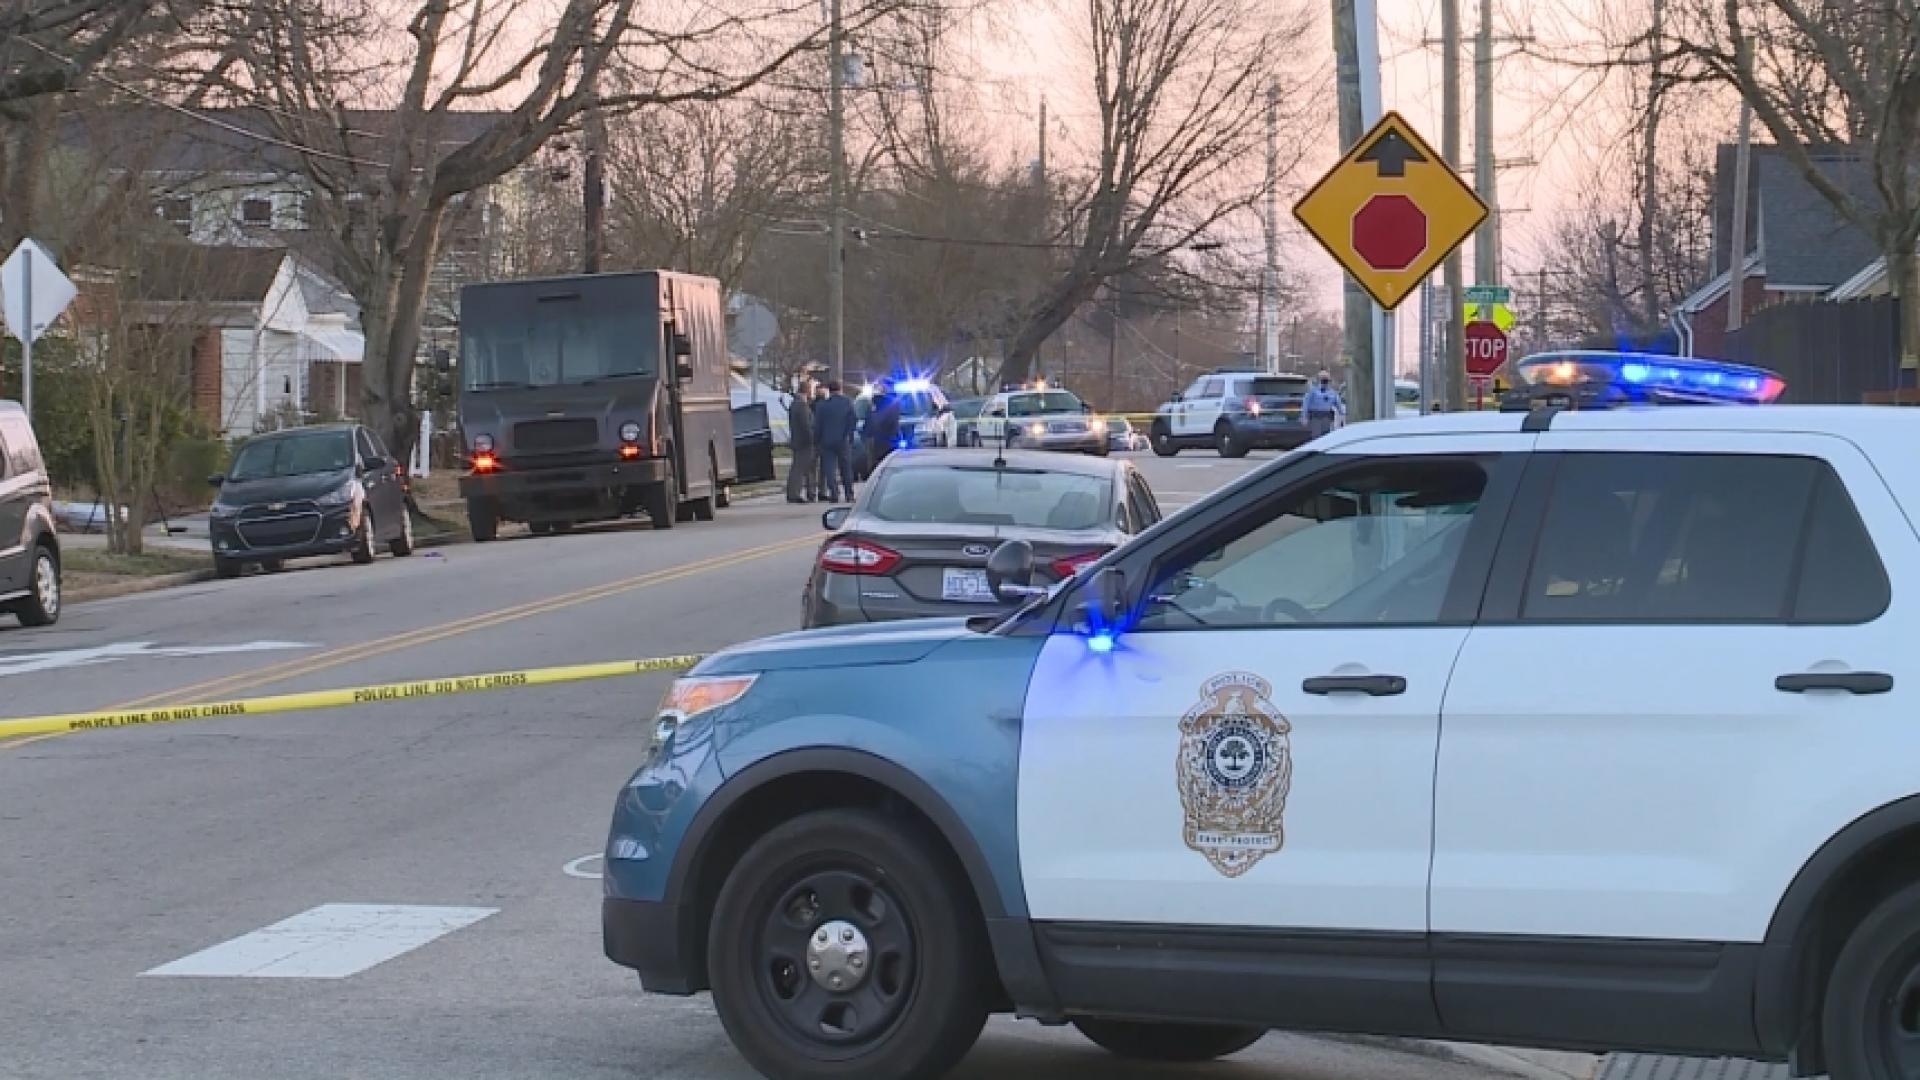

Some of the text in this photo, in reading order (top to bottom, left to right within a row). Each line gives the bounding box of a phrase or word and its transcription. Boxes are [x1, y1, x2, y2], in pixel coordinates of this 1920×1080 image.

[354, 672, 527, 702] POLICE LINE DO NOT CROSS
[120, 713, 146, 725] LINE
[151, 710, 171, 722] DO
[174, 708, 198, 719] NOT
[203, 702, 245, 716] CROSS
